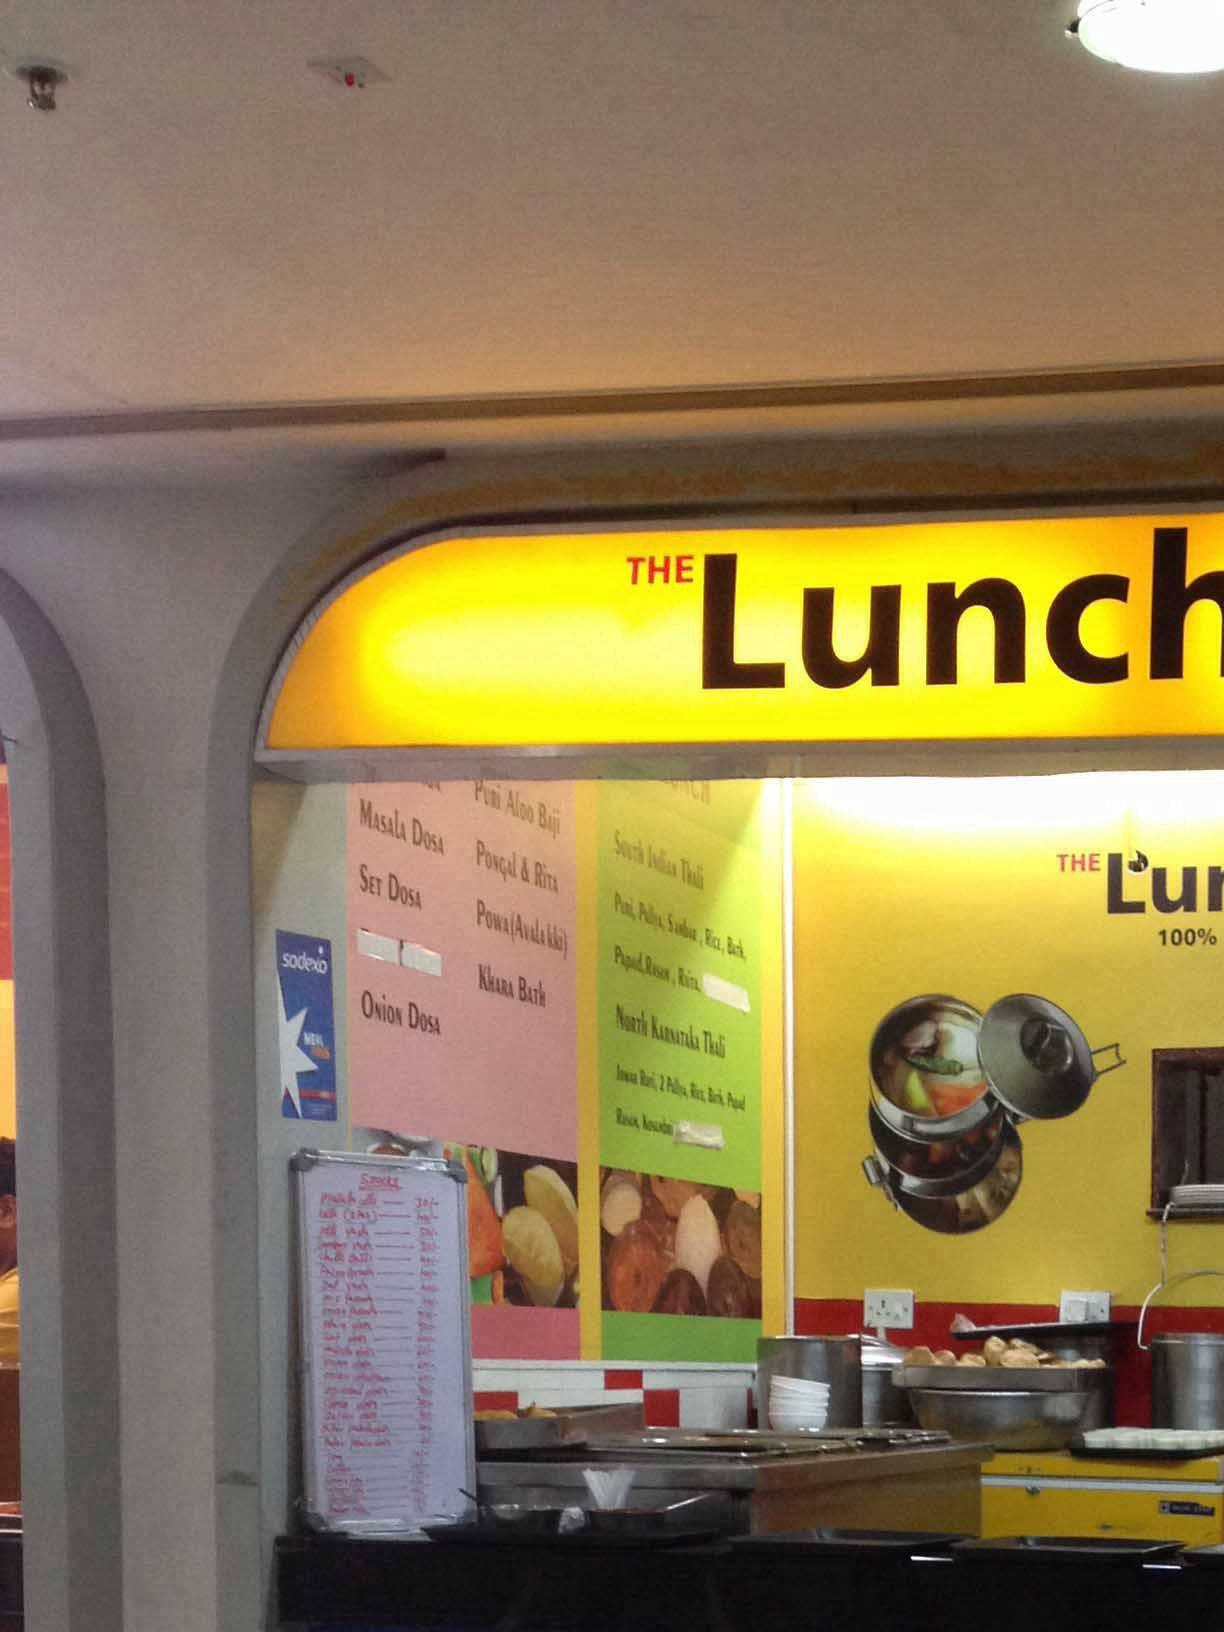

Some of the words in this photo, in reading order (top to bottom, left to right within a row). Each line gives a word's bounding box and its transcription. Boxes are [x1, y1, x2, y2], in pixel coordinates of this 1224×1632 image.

[626, 555, 695, 585] THE
[1056, 854, 1101, 873] THE
[1157, 928, 1218, 946] 100%
[281, 951, 328, 975] sodexo
